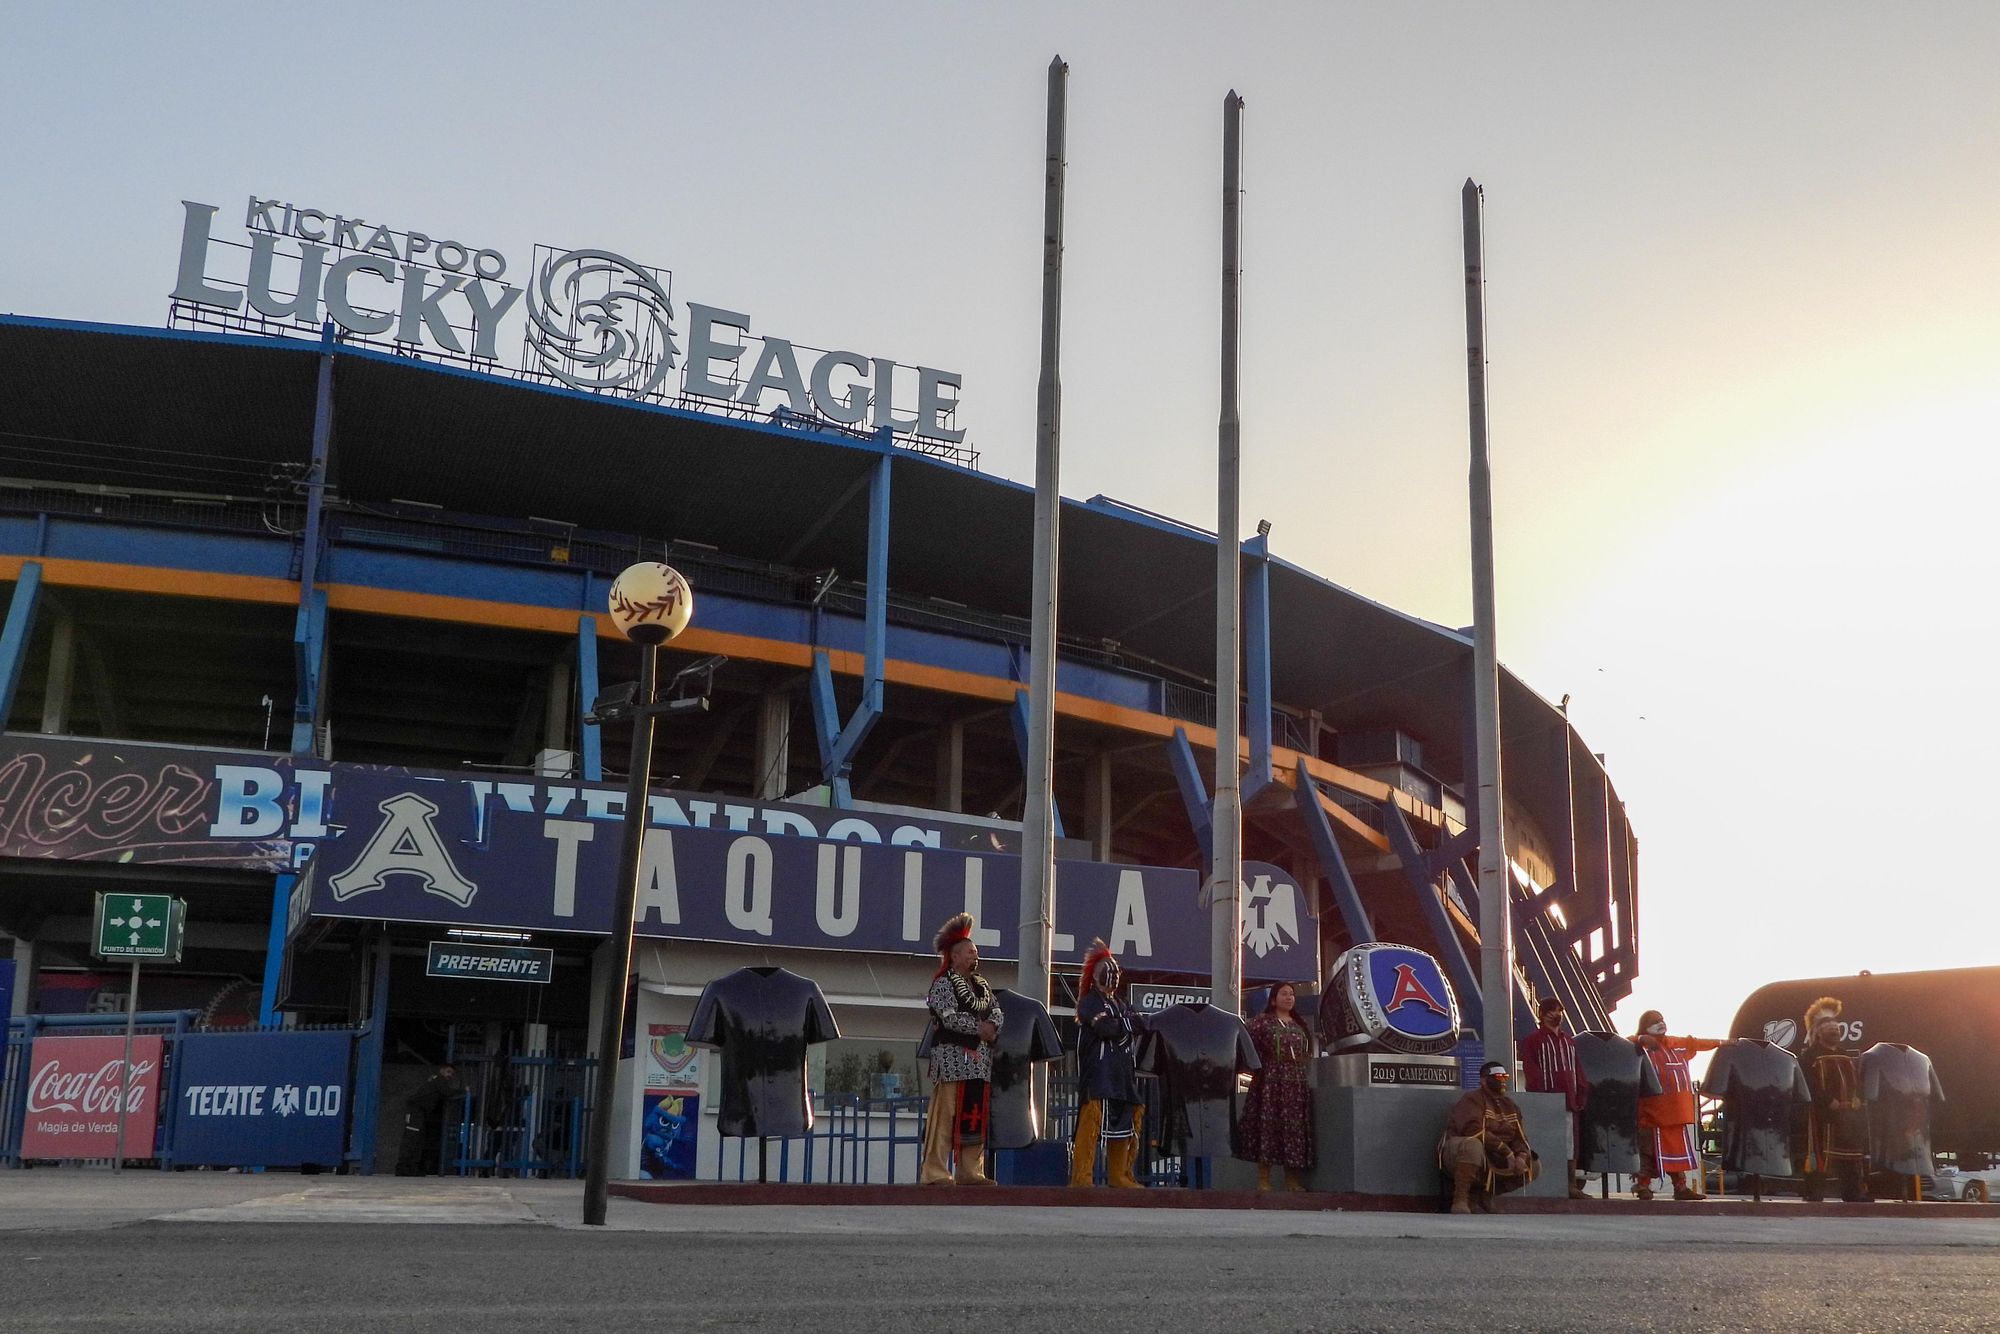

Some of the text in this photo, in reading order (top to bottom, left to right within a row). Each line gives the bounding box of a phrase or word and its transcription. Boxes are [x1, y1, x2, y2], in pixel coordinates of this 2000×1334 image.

[246, 195, 506, 280] KICKAPOO
[169, 200, 967, 444] LUCKY EAGLE
[329, 791, 479, 909] A
[102, 945, 125, 953] PUNTO
[135, 946, 164, 954] REUNIÓN
[437, 954, 541, 975] PREFERENTE
[1386, 963, 1449, 1017] A
[26, 1059, 156, 1113] Coca-Cola
[1373, 1067, 1396, 1083] 2019
[1398, 1067, 1447, 1082] CAMPEONES
[185, 1085, 342, 1117] TECATE 0.0
[38, 1121, 118, 1135] Magia de Verda
